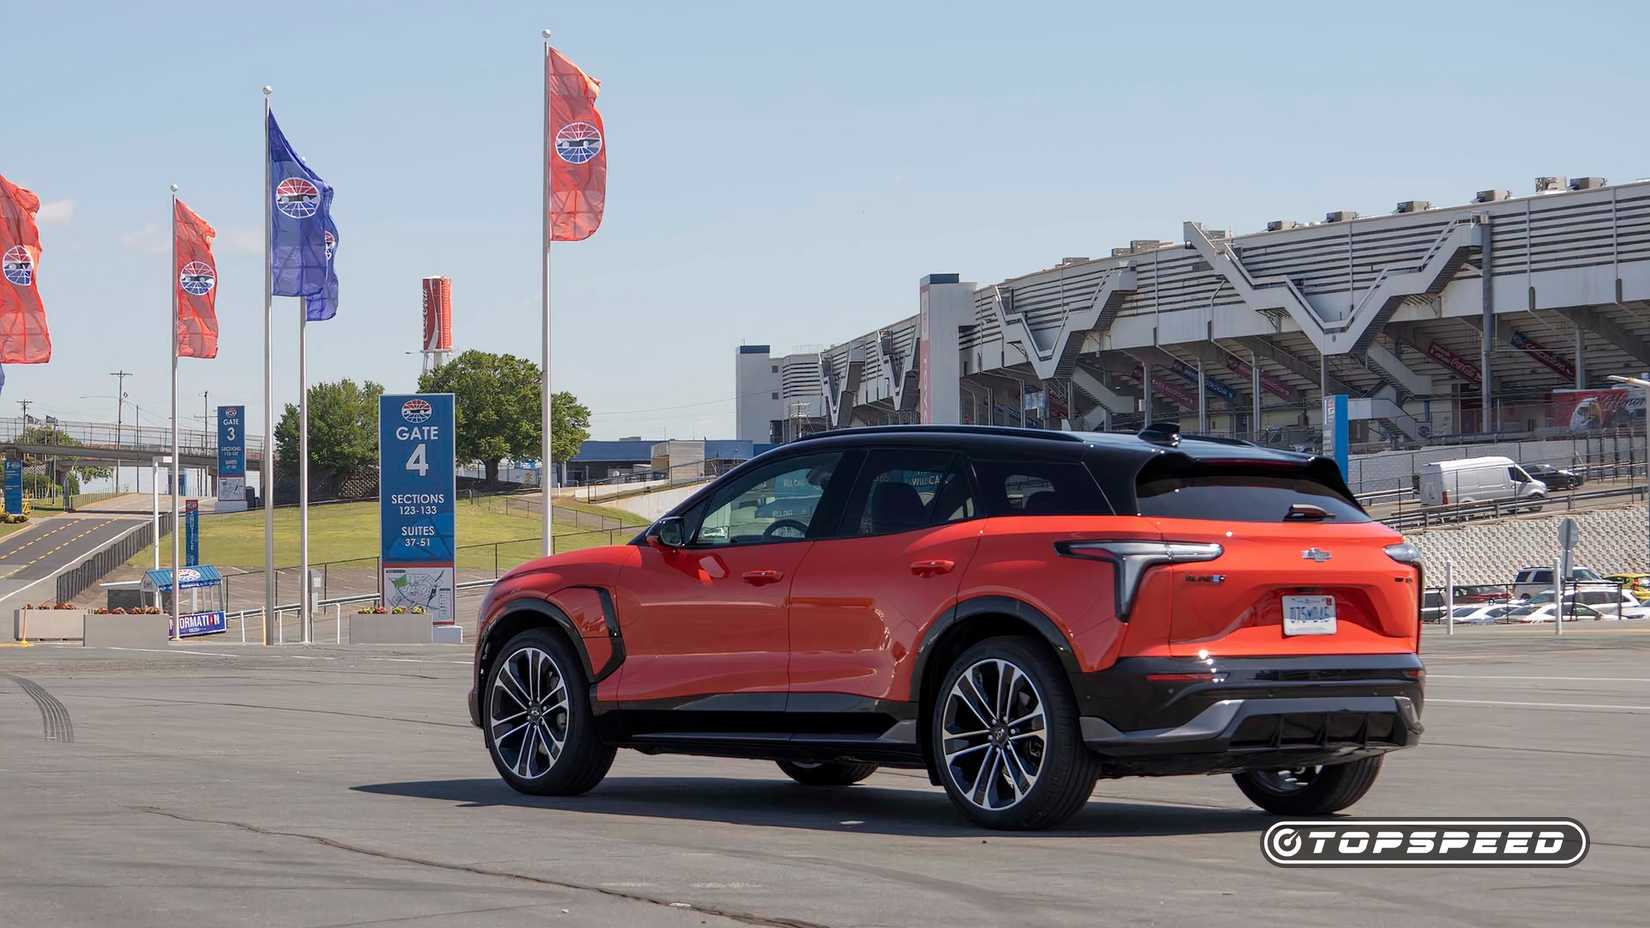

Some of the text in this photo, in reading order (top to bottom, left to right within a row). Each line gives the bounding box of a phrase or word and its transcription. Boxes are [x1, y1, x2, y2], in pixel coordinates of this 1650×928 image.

[222, 418, 240, 426] GATE
[226, 427, 236, 441] 3
[396, 426, 439, 440] GATE
[406, 443, 429, 476] 4
[391, 494, 445, 504] SECTIONS
[399, 505, 437, 515] 123-133
[401, 526, 435, 536] SUITES
[404, 538, 430, 547] 37-51
[169, 614, 220, 630] ORMATIN
